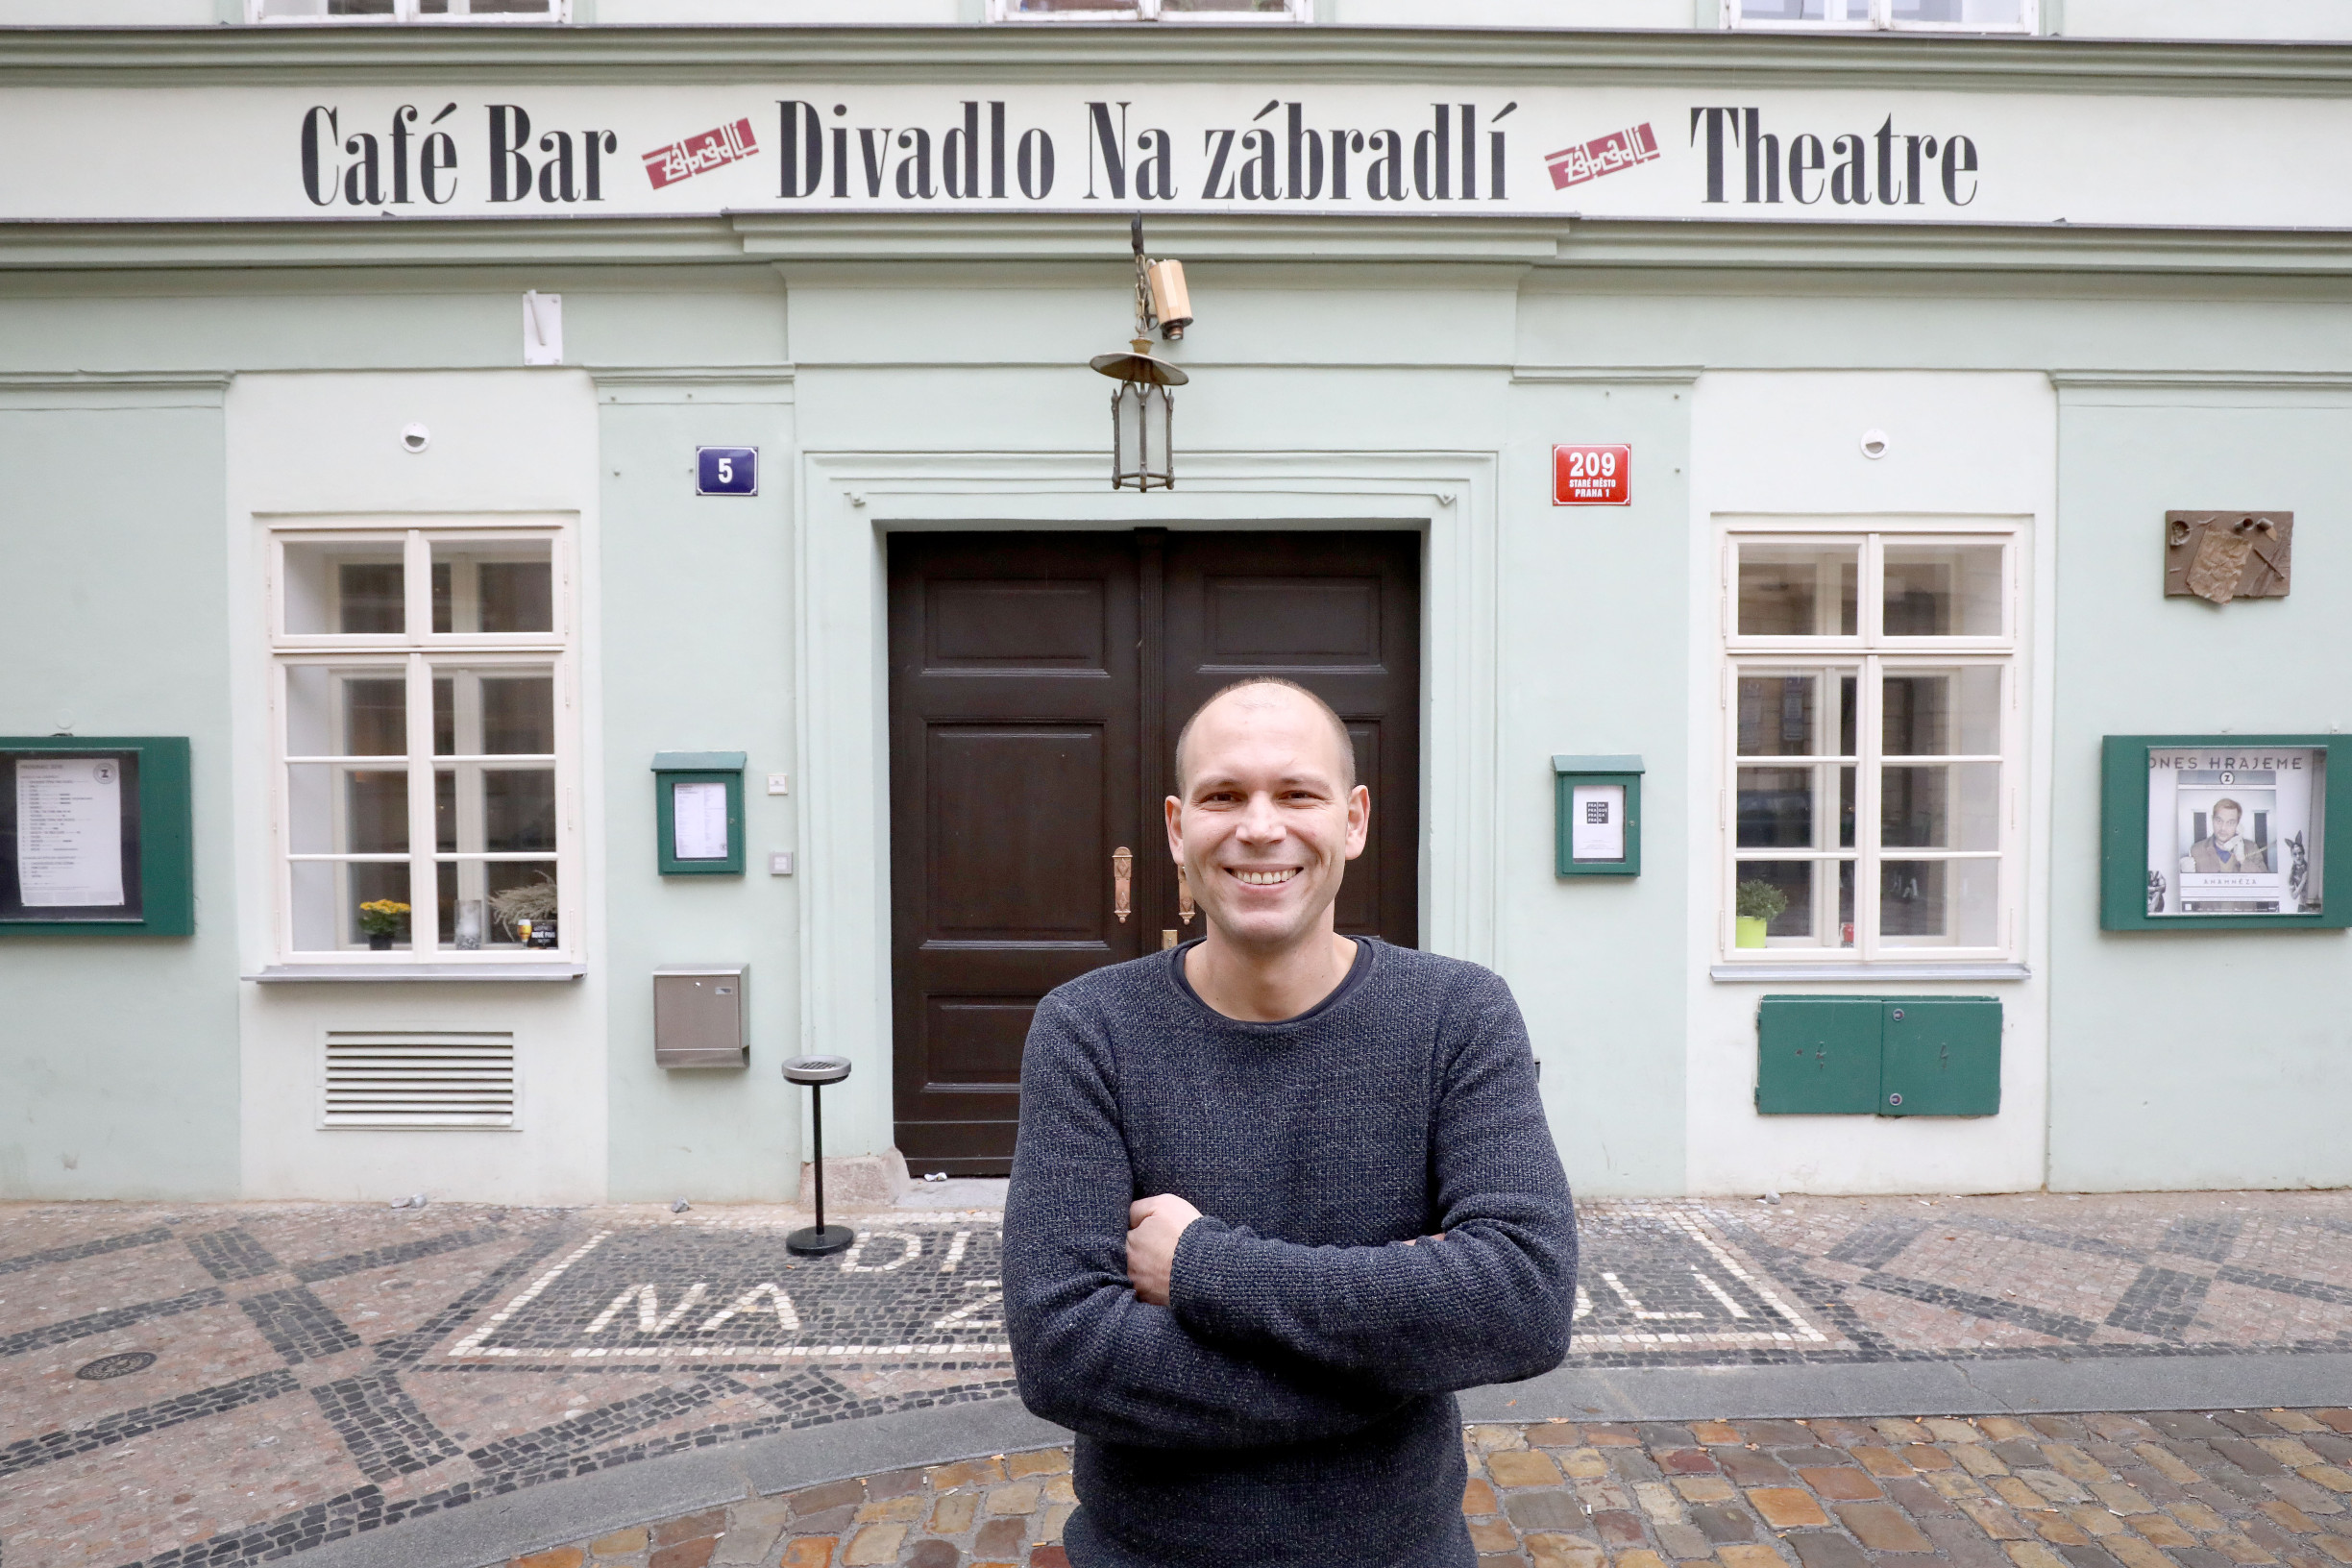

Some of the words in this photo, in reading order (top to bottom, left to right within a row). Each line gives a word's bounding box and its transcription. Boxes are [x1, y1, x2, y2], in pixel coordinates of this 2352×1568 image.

[300, 102, 458, 207] Café
[484, 104, 618, 203] Bar
[775, 100, 1055, 200] Divadlo
[1083, 102, 1178, 200] Na
[1201, 100, 1518, 201] zábradlí
[1690, 107, 1978, 207] Theatre
[718, 457, 733, 483] 5
[1569, 452, 1616, 478] 209
[1569, 478, 1591, 488] STARÉ
[1592, 478, 1616, 488] MĚSTO
[1575, 488, 1603, 498] PRAHA
[1605, 488, 1610, 498] 1
[2209, 757, 2303, 770] HRAJEME
[582, 1282, 800, 1333] NA
